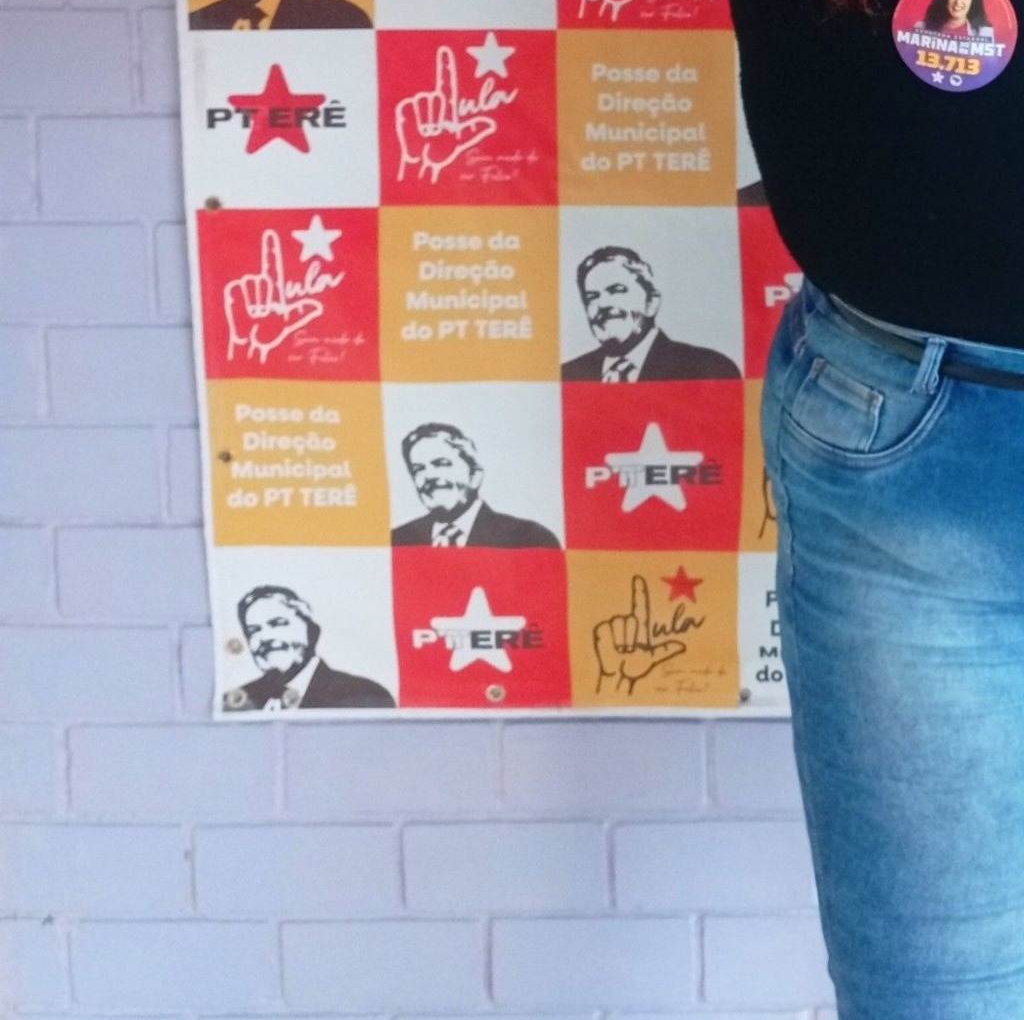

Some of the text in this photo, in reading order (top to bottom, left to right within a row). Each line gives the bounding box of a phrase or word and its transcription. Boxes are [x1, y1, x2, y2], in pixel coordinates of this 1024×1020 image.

[970, 42, 1006, 58] MST
[591, 62, 699, 84] Posse da
[916, 50, 982, 76] 13.713
[597, 91, 693, 118] Direção
[585, 121, 707, 146] Municipal
[579, 147, 711, 172] do PT TERÊ
[412, 231, 522, 251] Posse da
[418, 259, 516, 285] Direção
[405, 289, 528, 313] Municipal
[400, 315, 533, 341] do PT TERÊ
[234, 403, 341, 425] Posse da
[242, 431, 337, 455] Direção
[229, 459, 352, 481] Municipal
[226, 483, 358, 509] do PT TERÊ
[756, 664, 784, 683] do
